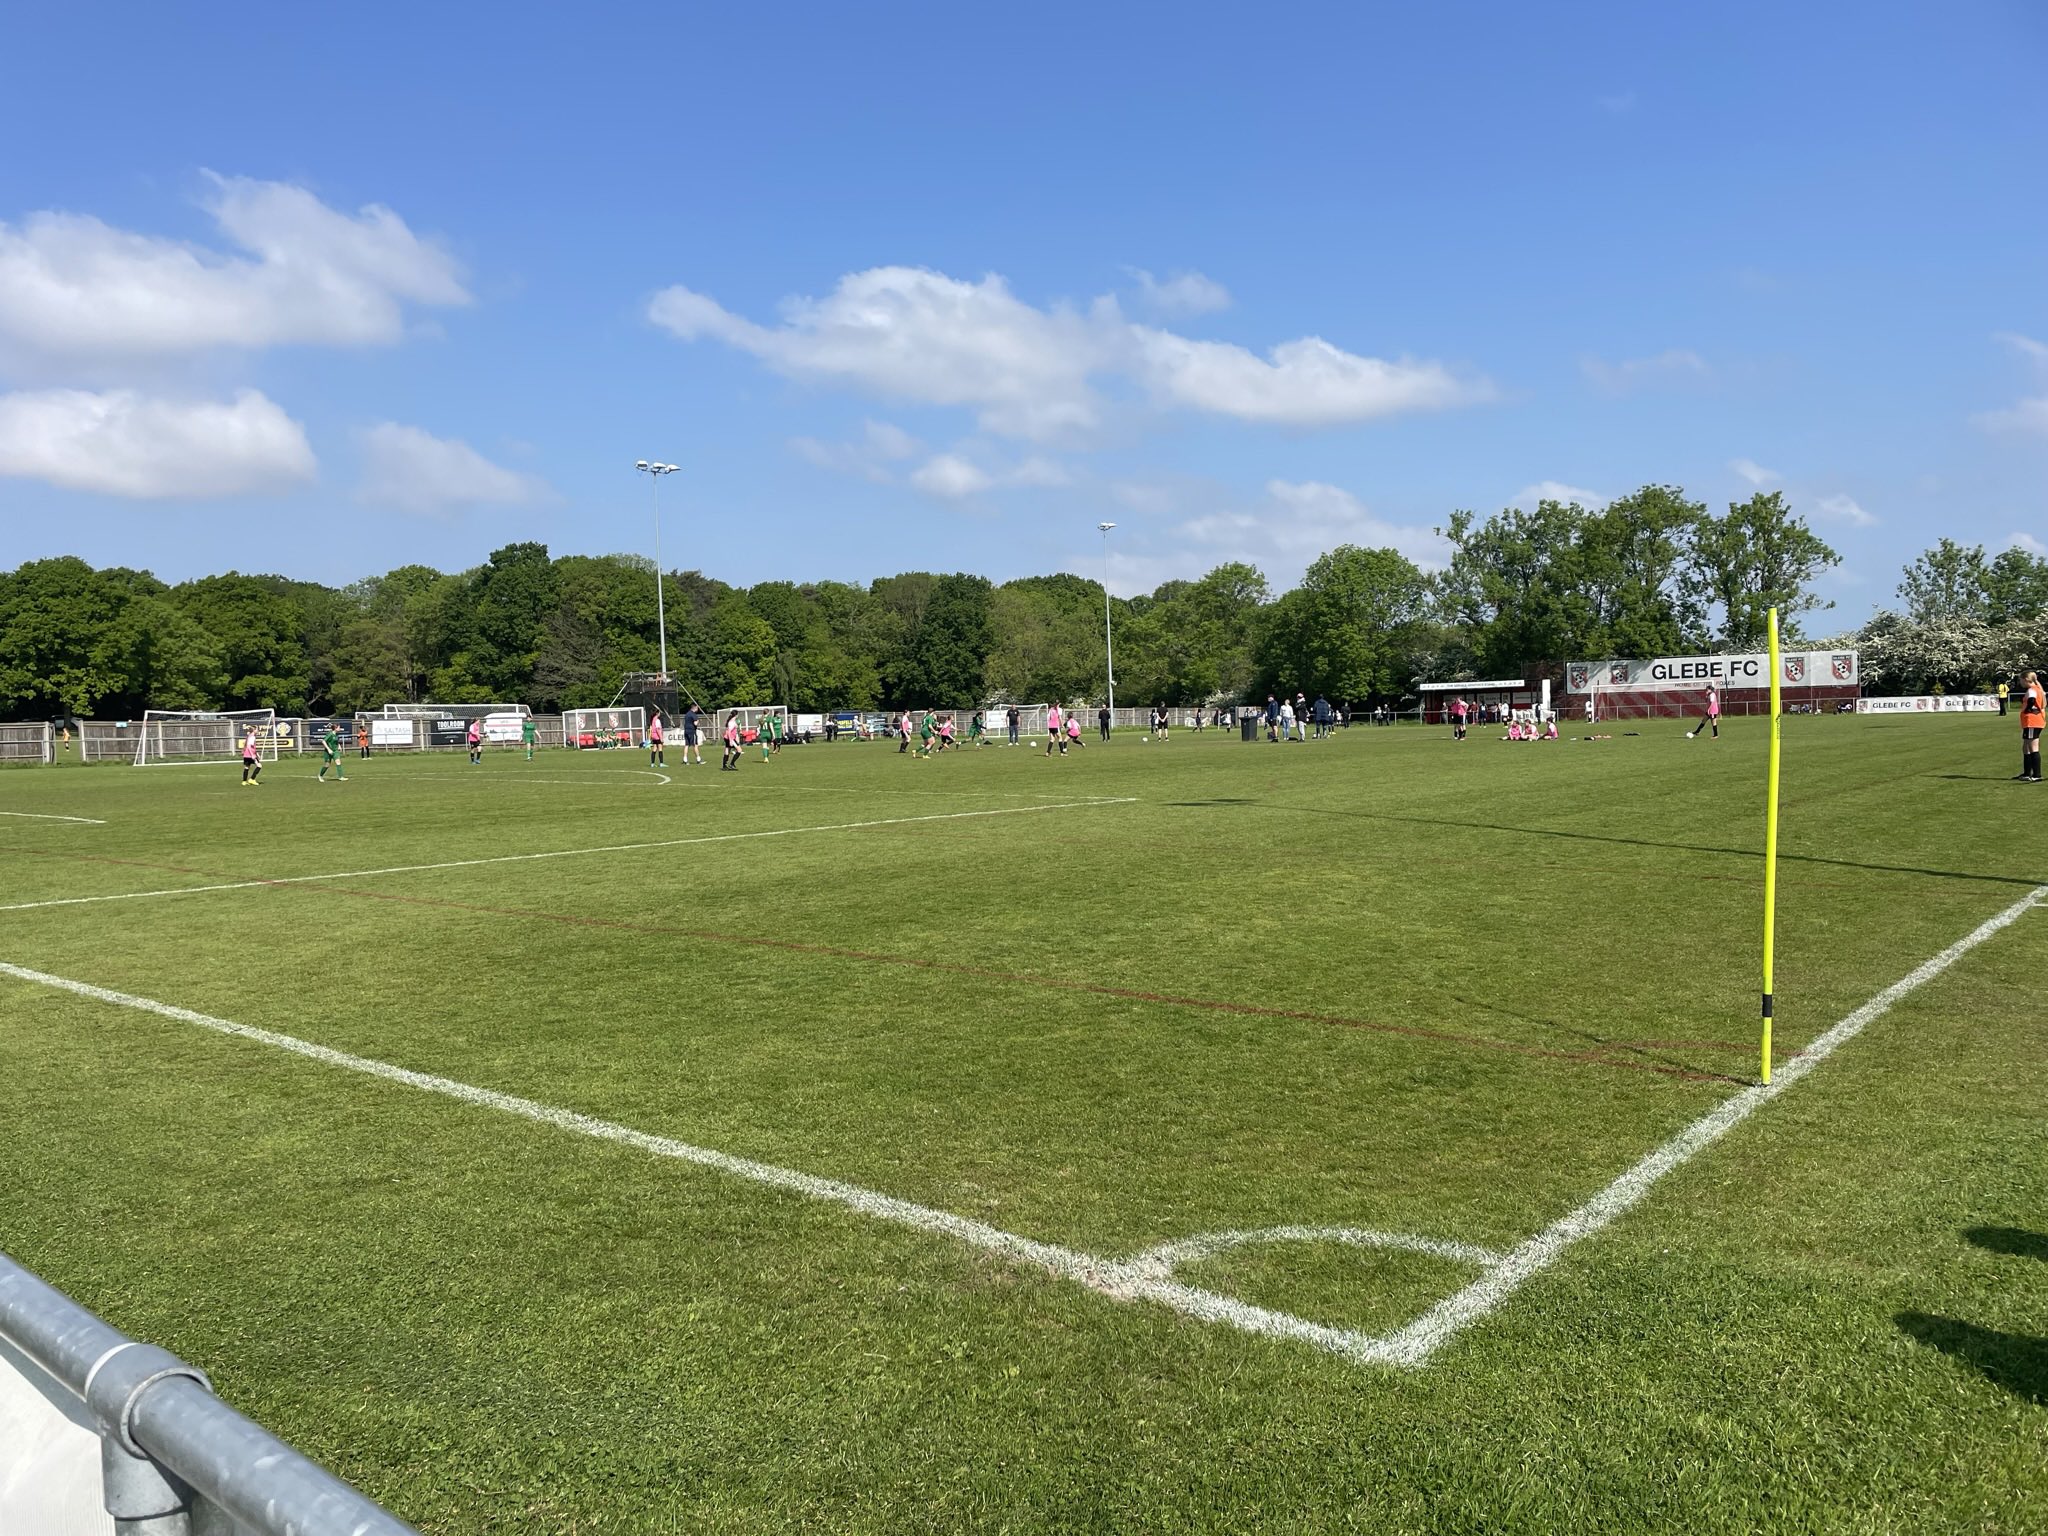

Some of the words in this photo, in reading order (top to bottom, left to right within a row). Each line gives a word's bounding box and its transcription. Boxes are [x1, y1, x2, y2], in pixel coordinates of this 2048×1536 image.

[1651, 661, 1723, 680] GLEBE
[1730, 660, 1759, 677] FC
[437, 721, 465, 729] TOOLROOM
